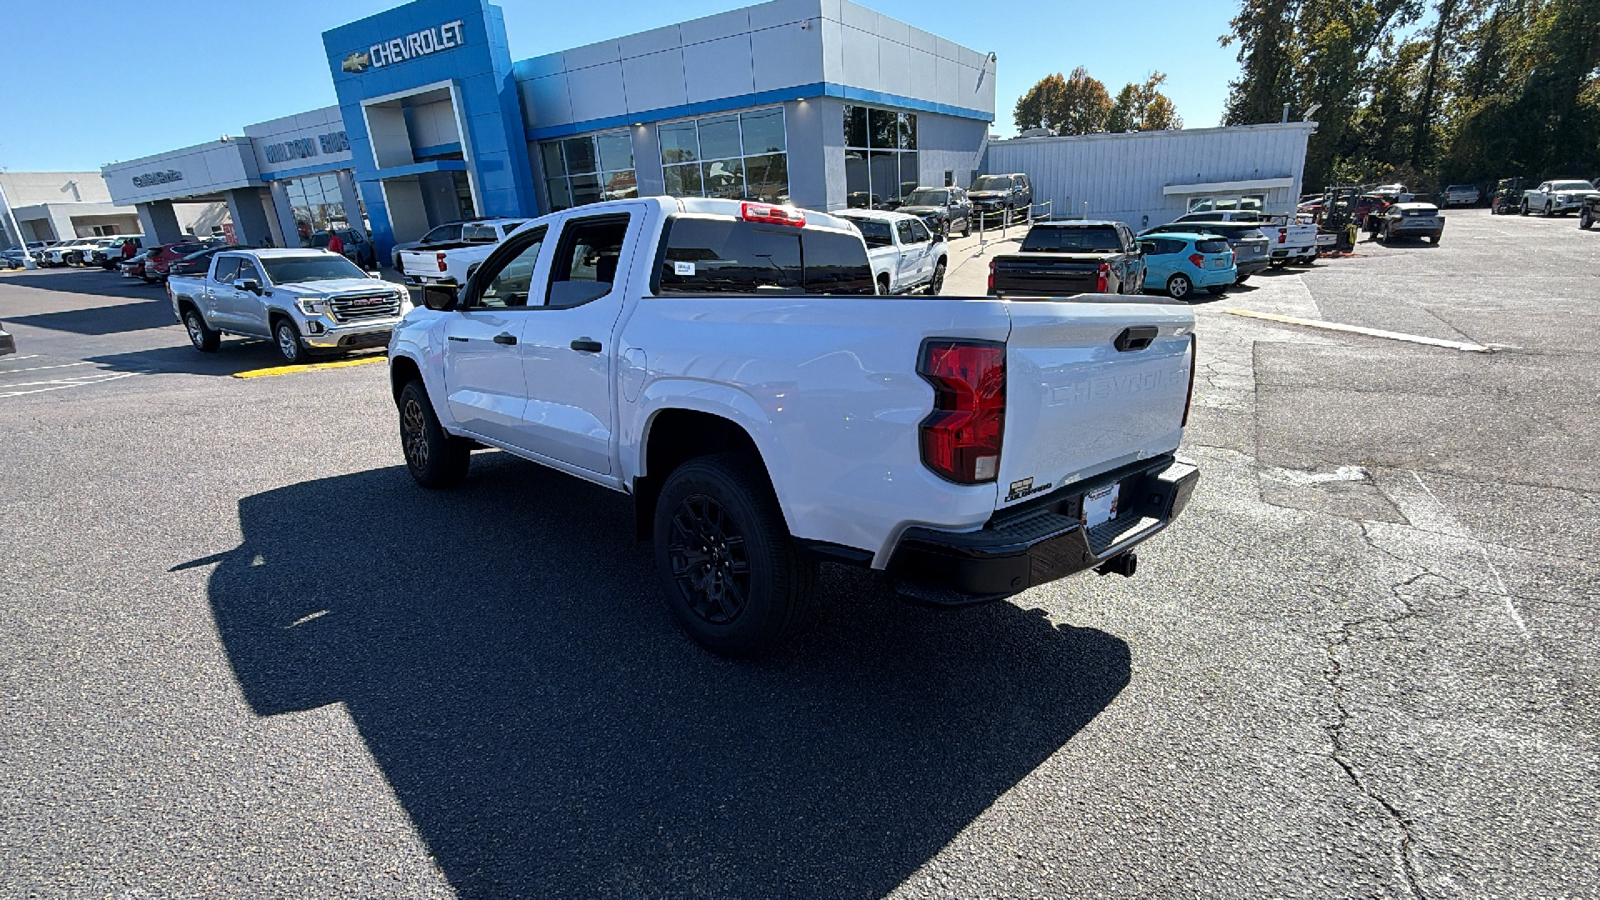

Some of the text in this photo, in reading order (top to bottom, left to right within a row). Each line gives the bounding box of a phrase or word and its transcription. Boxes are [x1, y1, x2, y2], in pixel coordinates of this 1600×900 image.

[369, 20, 464, 68] CHEVROLET
[263, 138, 318, 163] MILTON
[1048, 369, 1188, 407] CHEVROLET
